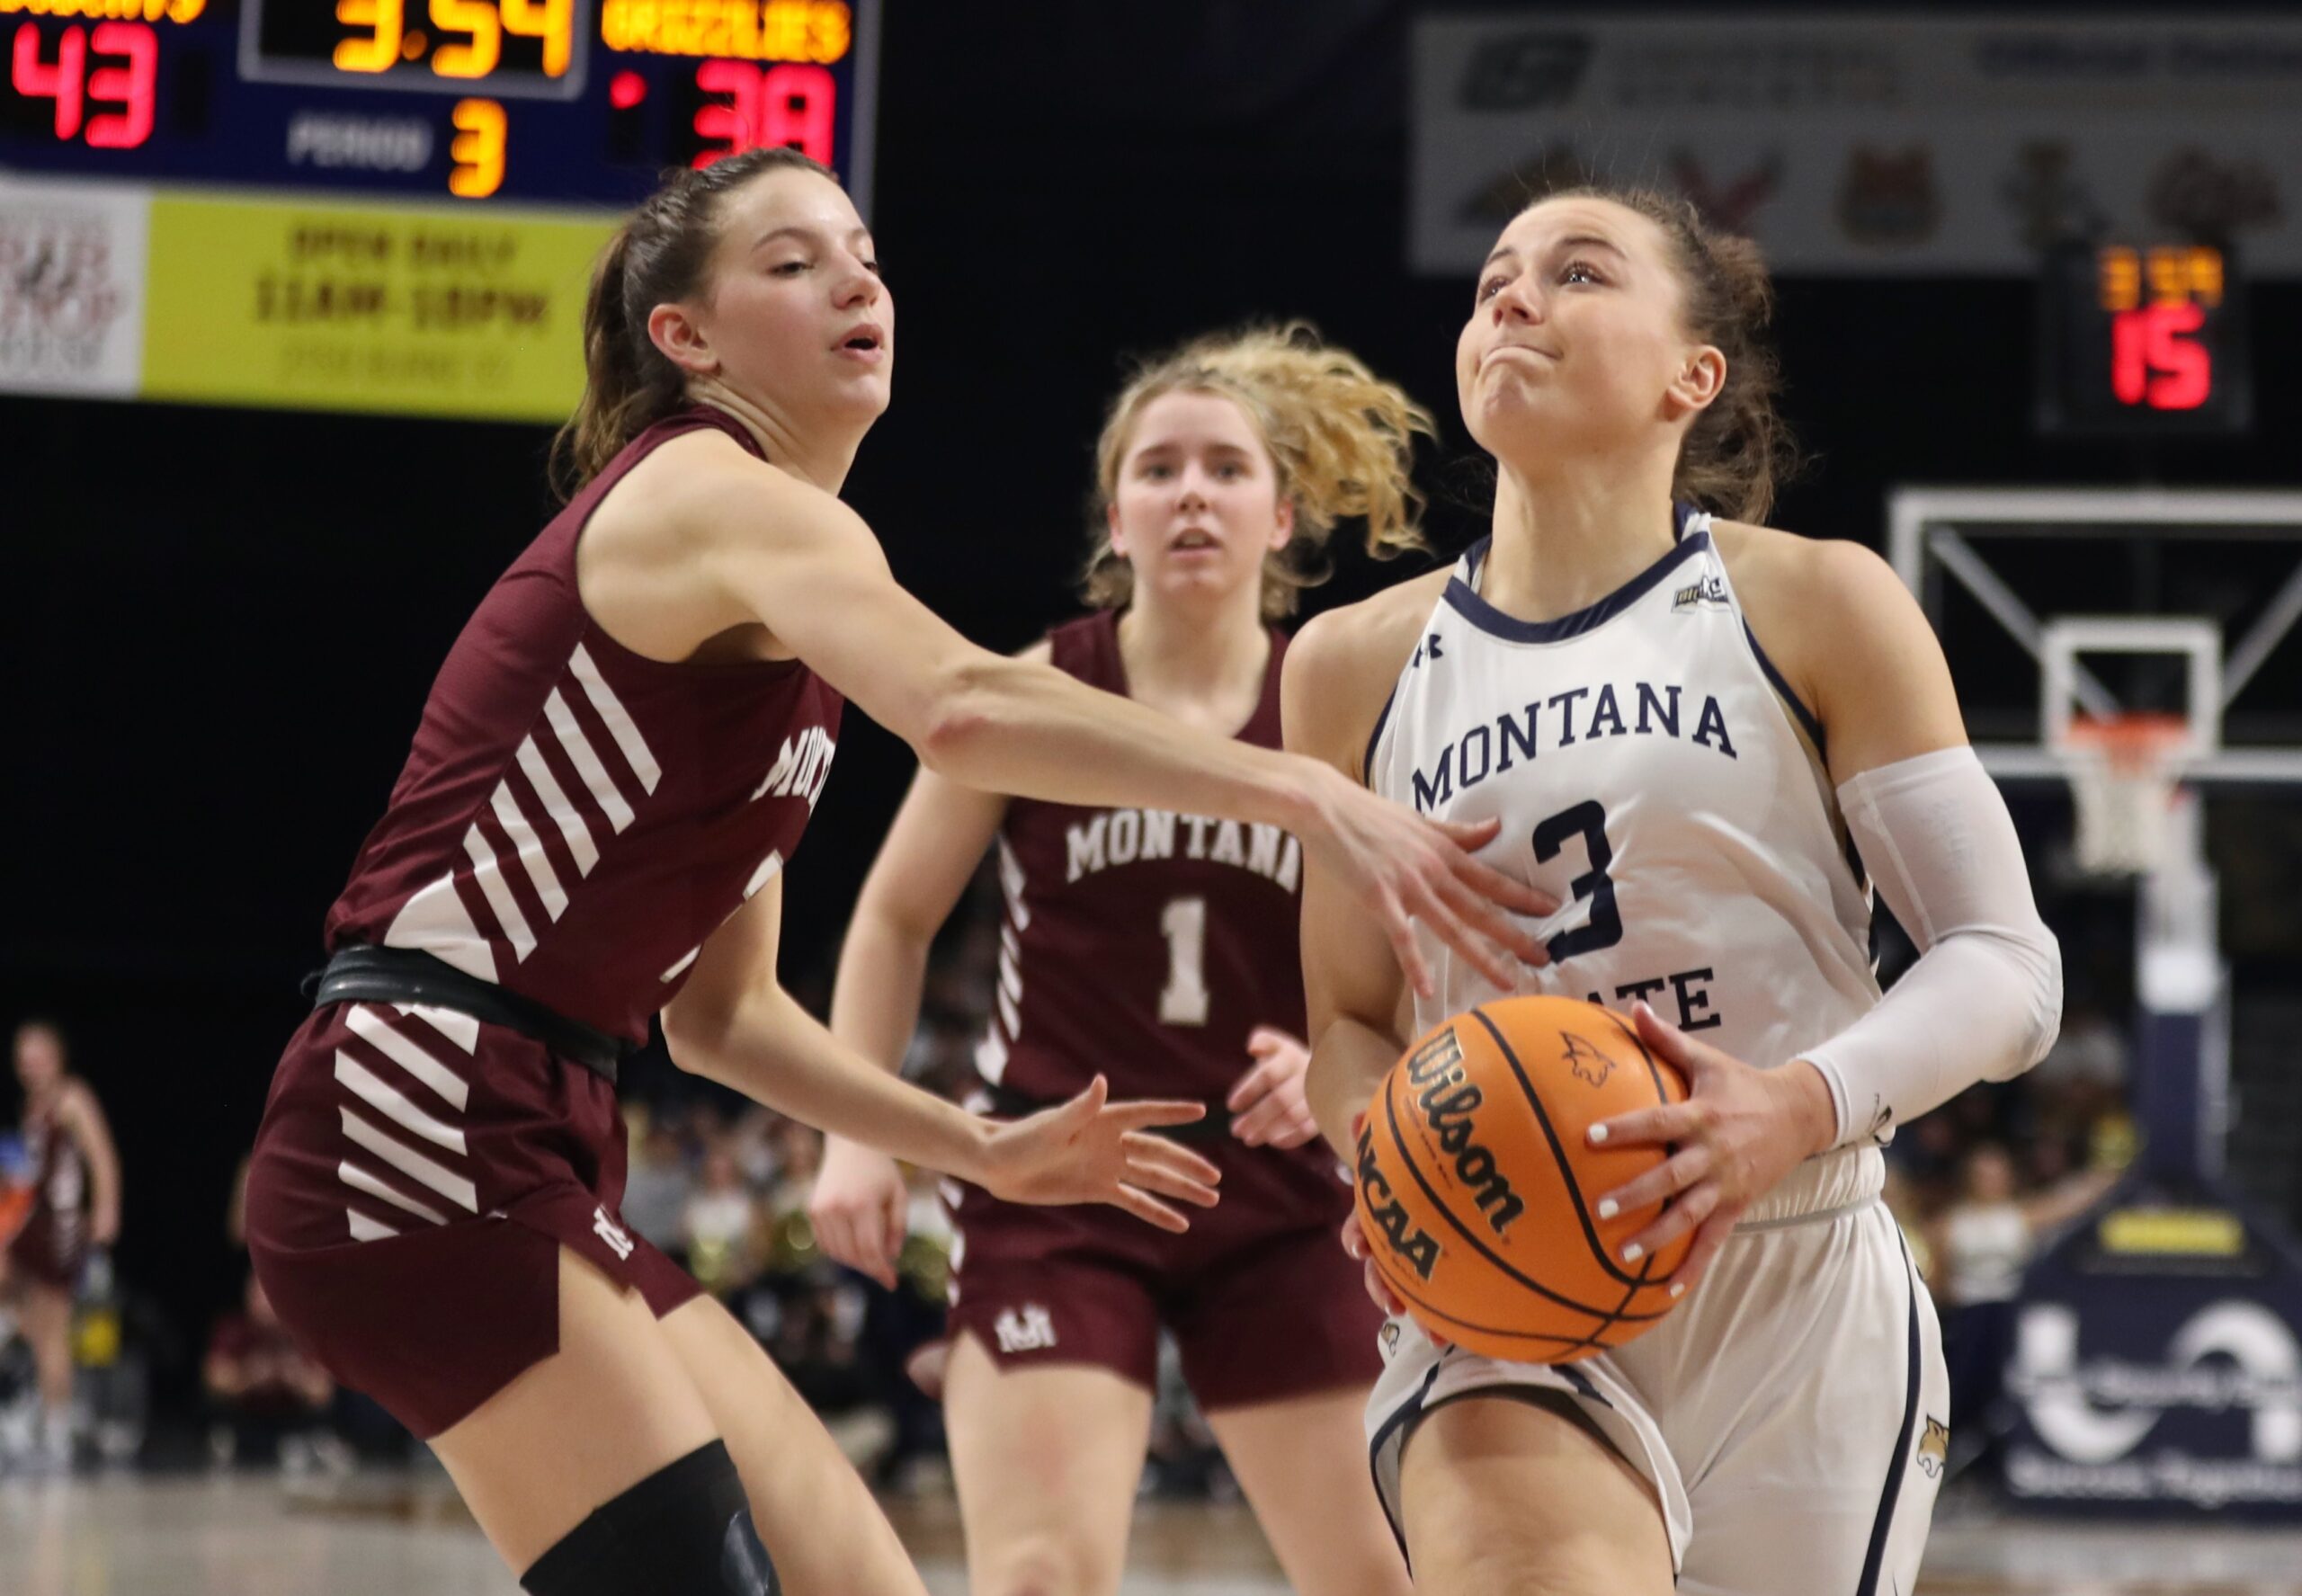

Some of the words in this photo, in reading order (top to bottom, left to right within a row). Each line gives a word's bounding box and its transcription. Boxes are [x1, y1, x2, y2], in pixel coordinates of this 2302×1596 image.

[12, 21, 158, 149] 43
[602, 0, 851, 64] GRIZZLIES
[449, 98, 508, 199] 3
[2110, 302, 2211, 410] 15
[1412, 682, 1737, 815] MONTANA
[1532, 799, 1623, 964] 3
[1159, 897, 1210, 1027] 1
[1407, 1024, 1524, 1235] Wilson
[1357, 1122, 1441, 1282] NCAA
